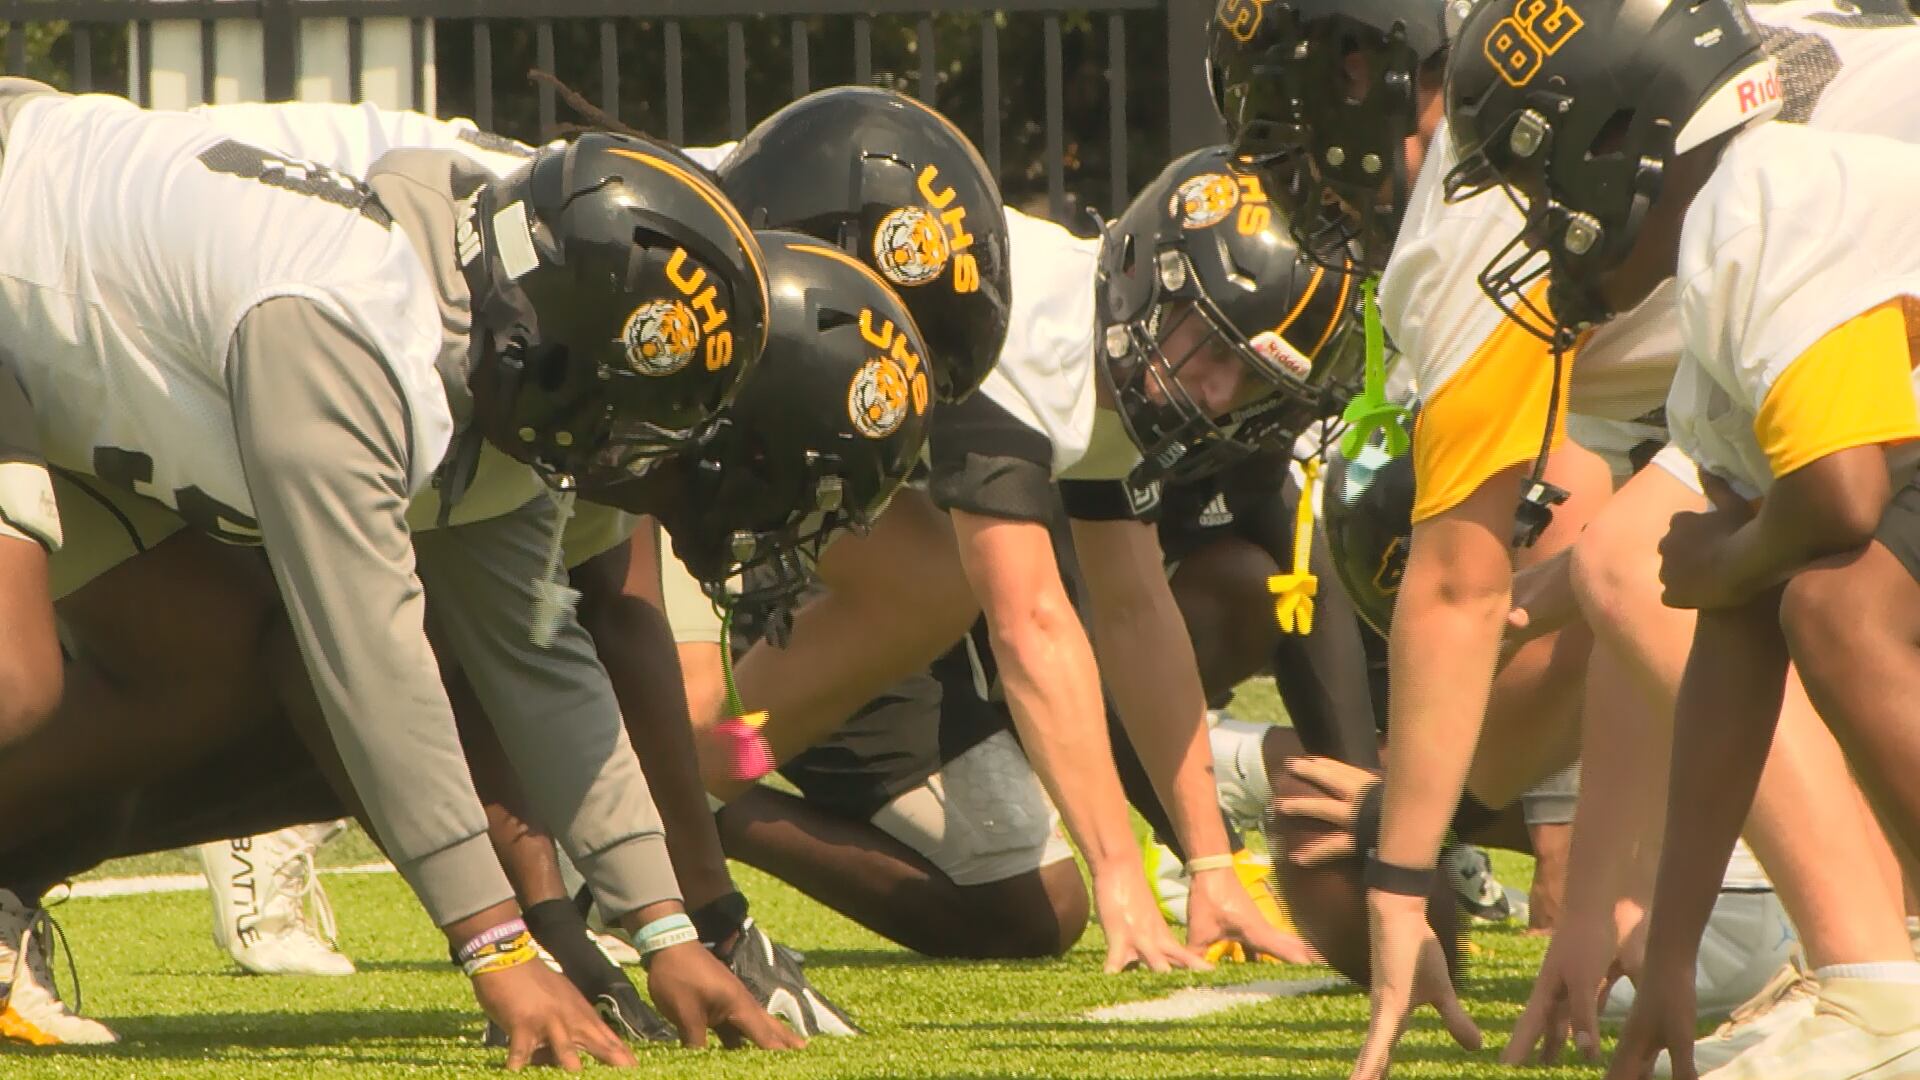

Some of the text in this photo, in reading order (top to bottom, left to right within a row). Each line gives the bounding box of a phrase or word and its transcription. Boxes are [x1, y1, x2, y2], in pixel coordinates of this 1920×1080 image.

[1484, 0, 1585, 88] 82
[917, 163, 980, 294] UHS
[1236, 156, 1271, 237] HS
[666, 247, 734, 372] UHS
[859, 308, 929, 417] UHS
[231, 836, 263, 950] BATTLE
